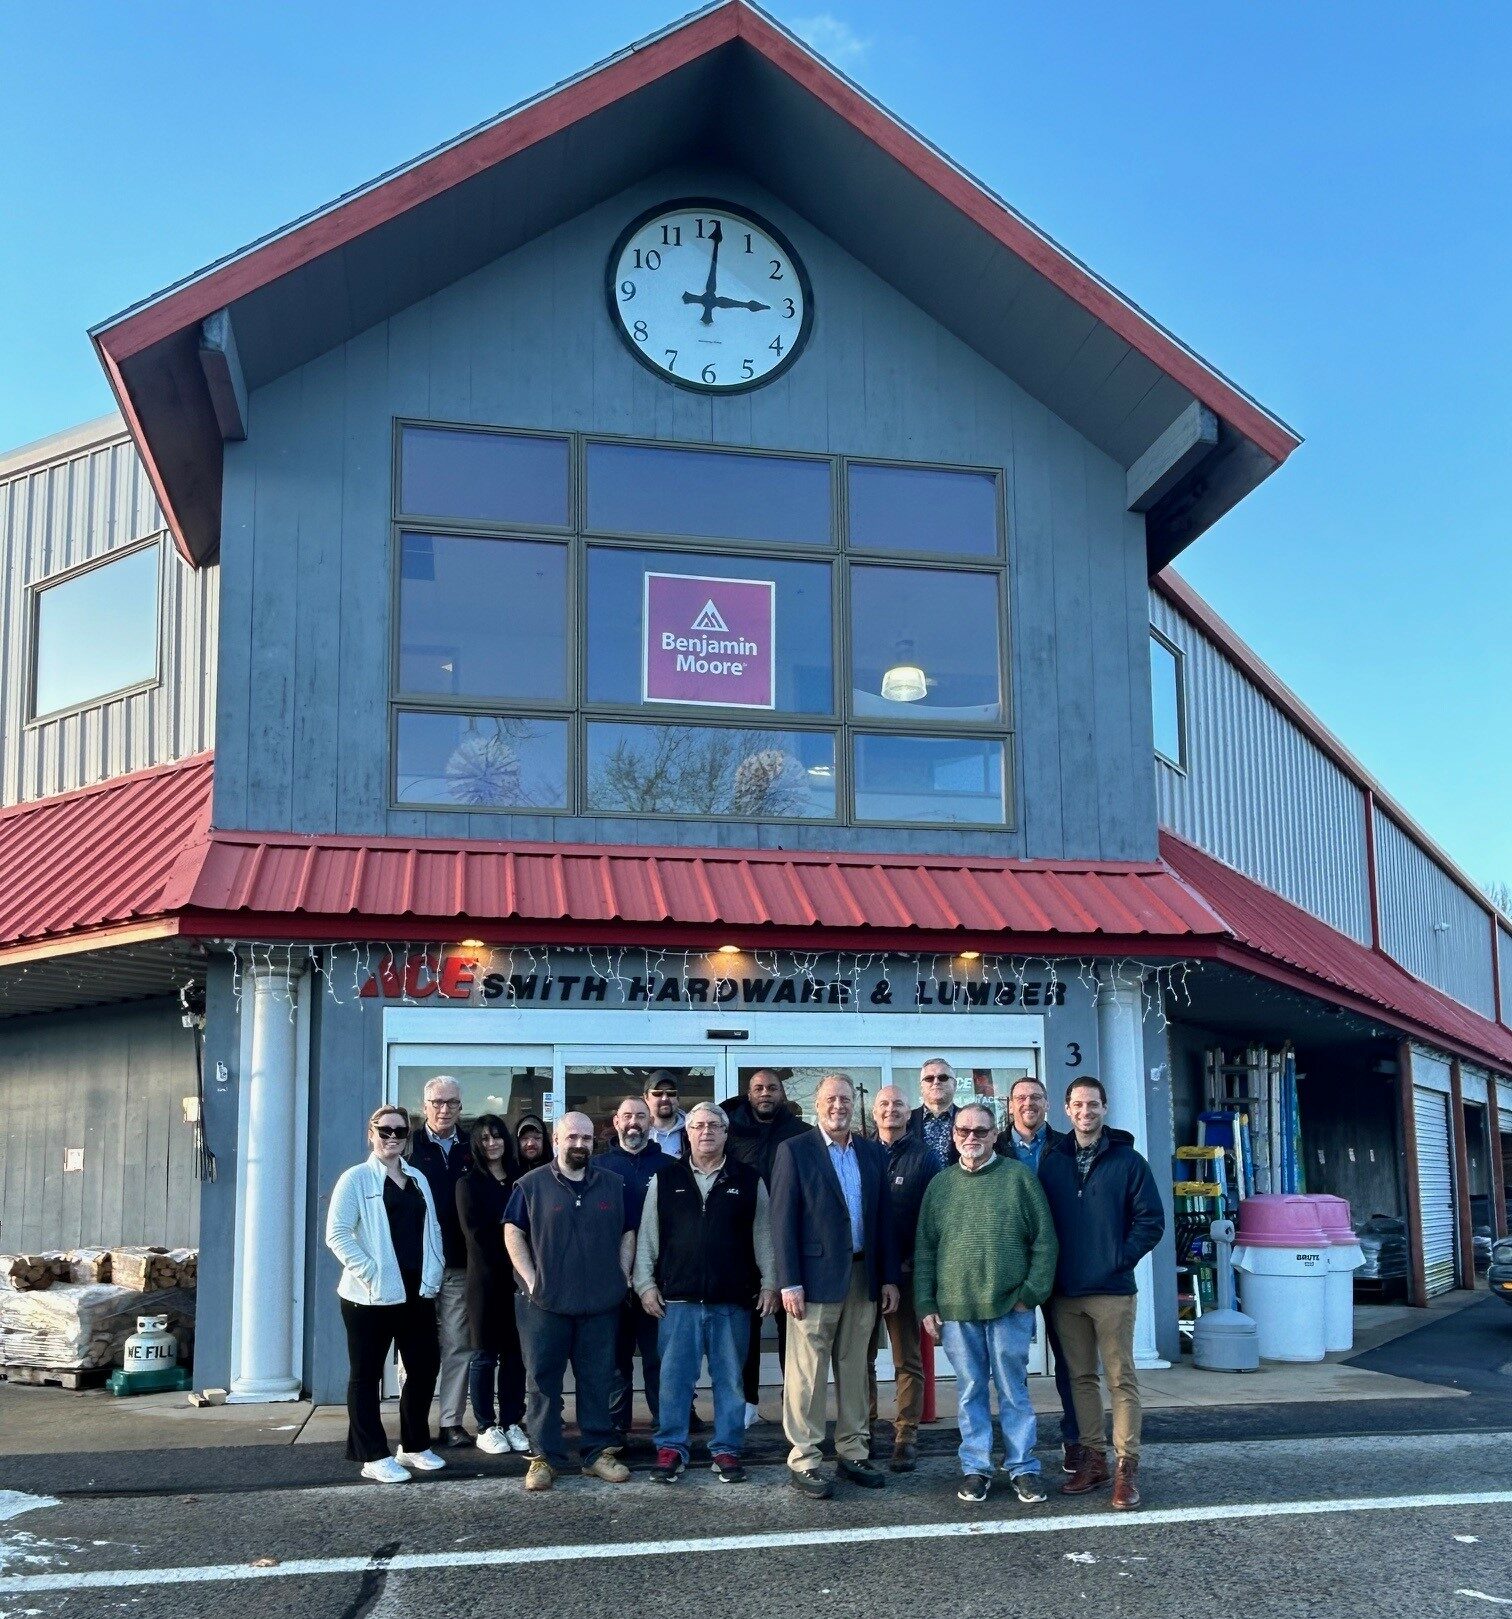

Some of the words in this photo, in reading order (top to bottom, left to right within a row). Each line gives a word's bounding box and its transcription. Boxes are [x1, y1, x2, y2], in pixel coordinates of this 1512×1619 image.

[661, 224, 682, 246] 11
[744, 233, 753, 253] 1
[633, 248, 661, 270] 10
[769, 260, 783, 280] 2
[621, 280, 636, 301] 9
[781, 298, 795, 318] 3
[633, 320, 648, 341] 8
[768, 335, 783, 356] 4
[665, 349, 678, 371] 7
[741, 359, 754, 379] 5
[701, 363, 716, 383] 6
[661, 632, 758, 657] Benjamin
[676, 654, 742, 676] Moore
[360, 953, 478, 998] ACE
[481, 973, 608, 1001] SMITH
[628, 976, 853, 1004] HARDWARE
[870, 979, 893, 1004] &
[914, 980, 1067, 1006] LUMBER
[1065, 1042, 1082, 1067] 3
[128, 1345, 142, 1358] WE
[146, 1345, 174, 1358] FILL
